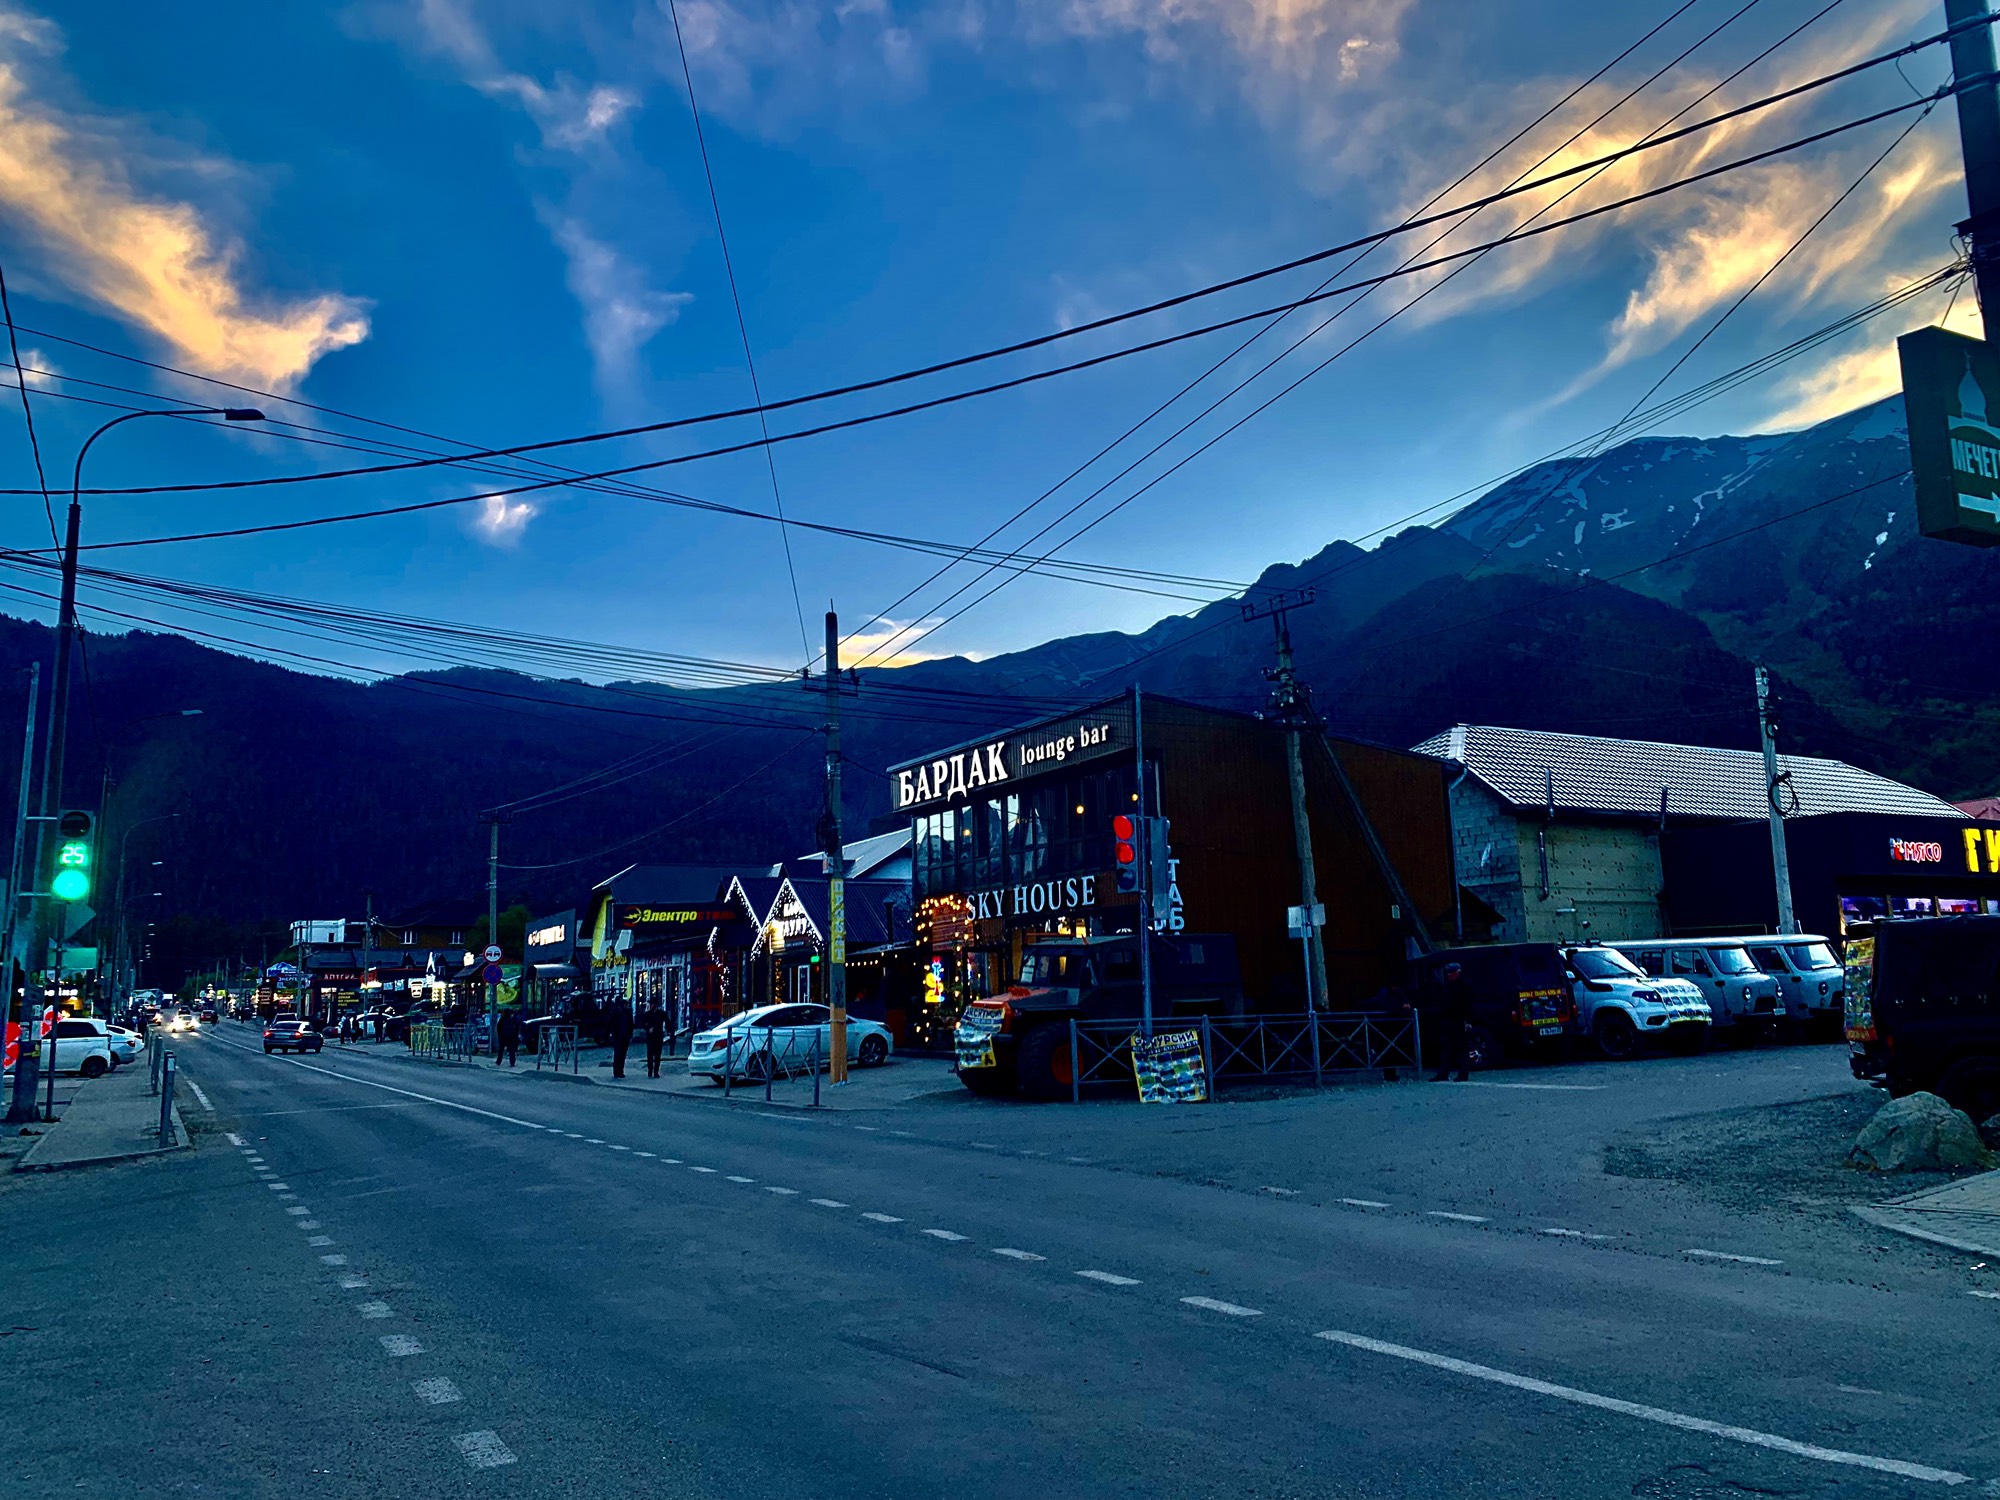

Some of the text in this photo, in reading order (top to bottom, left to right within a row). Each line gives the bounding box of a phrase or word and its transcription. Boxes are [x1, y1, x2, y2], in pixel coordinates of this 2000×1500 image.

[1951, 438, 2000, 479] МЕЧЕТ
[1021, 725, 1109, 765] lounge bar
[899, 742, 1008, 807] БАРДАК
[61, 846, 85, 865] 25
[1904, 841, 1942, 863] МЯСО
[966, 875, 1095, 920] SKY HOUSE
[1166, 858, 1184, 936] ТАБ
[1135, 1030, 1195, 1048] ЭККУРСИИ
